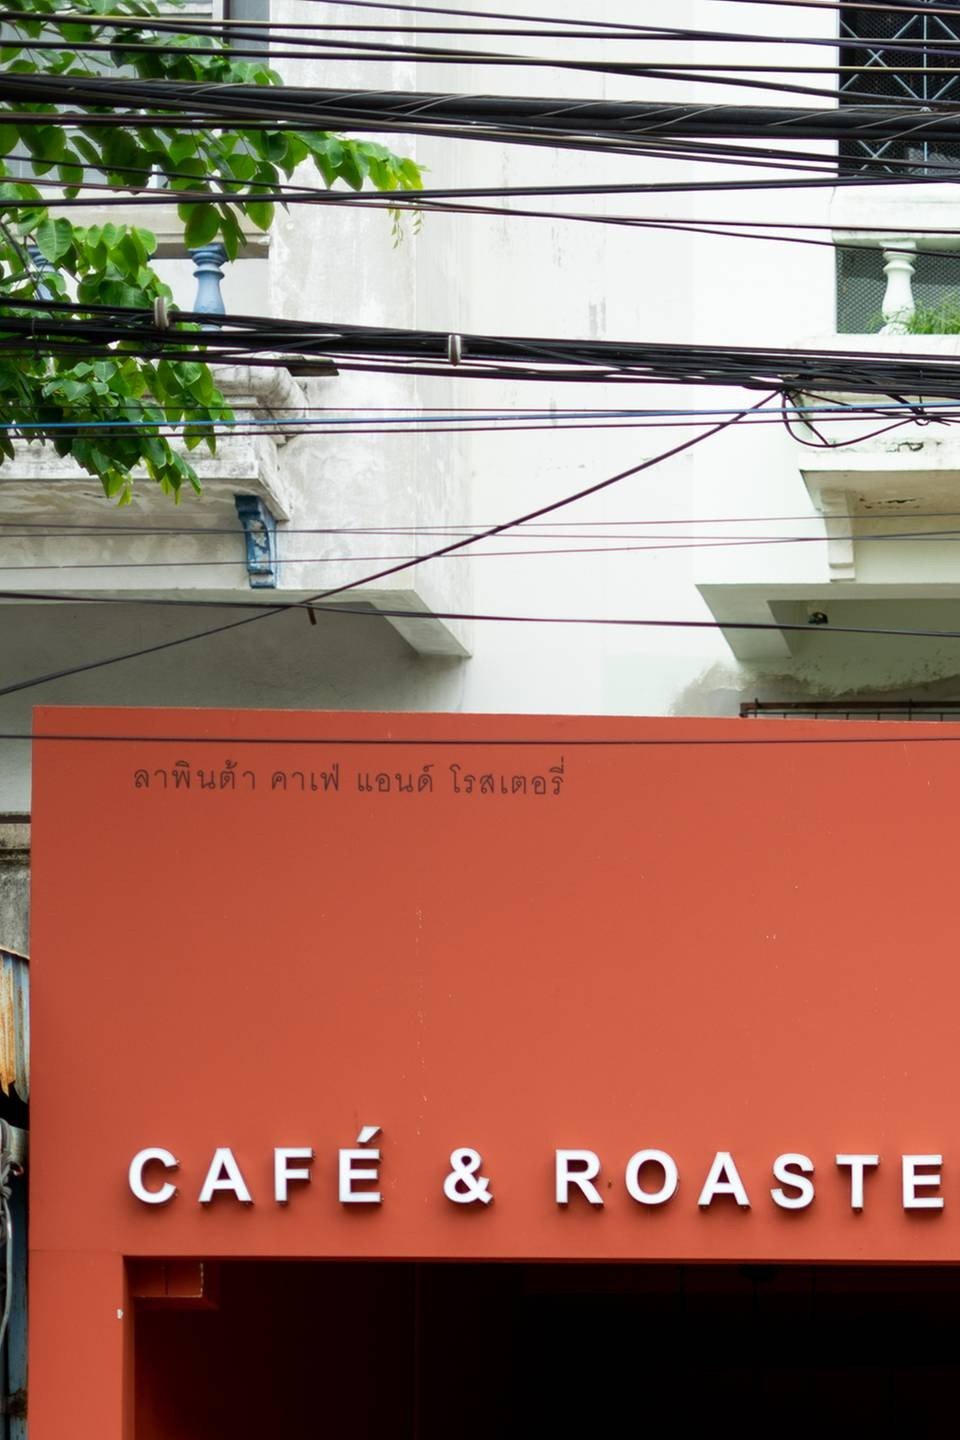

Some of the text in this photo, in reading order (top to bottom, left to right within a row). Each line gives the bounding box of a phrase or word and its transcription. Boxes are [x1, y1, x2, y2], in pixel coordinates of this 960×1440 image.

[133, 758, 257, 790] ลาพินต้า
[357, 764, 434, 793] แอนด์
[449, 756, 565, 796] โรสเตอรี่
[127, 1126, 383, 1206] CAFÉ
[443, 1147, 494, 1206] &
